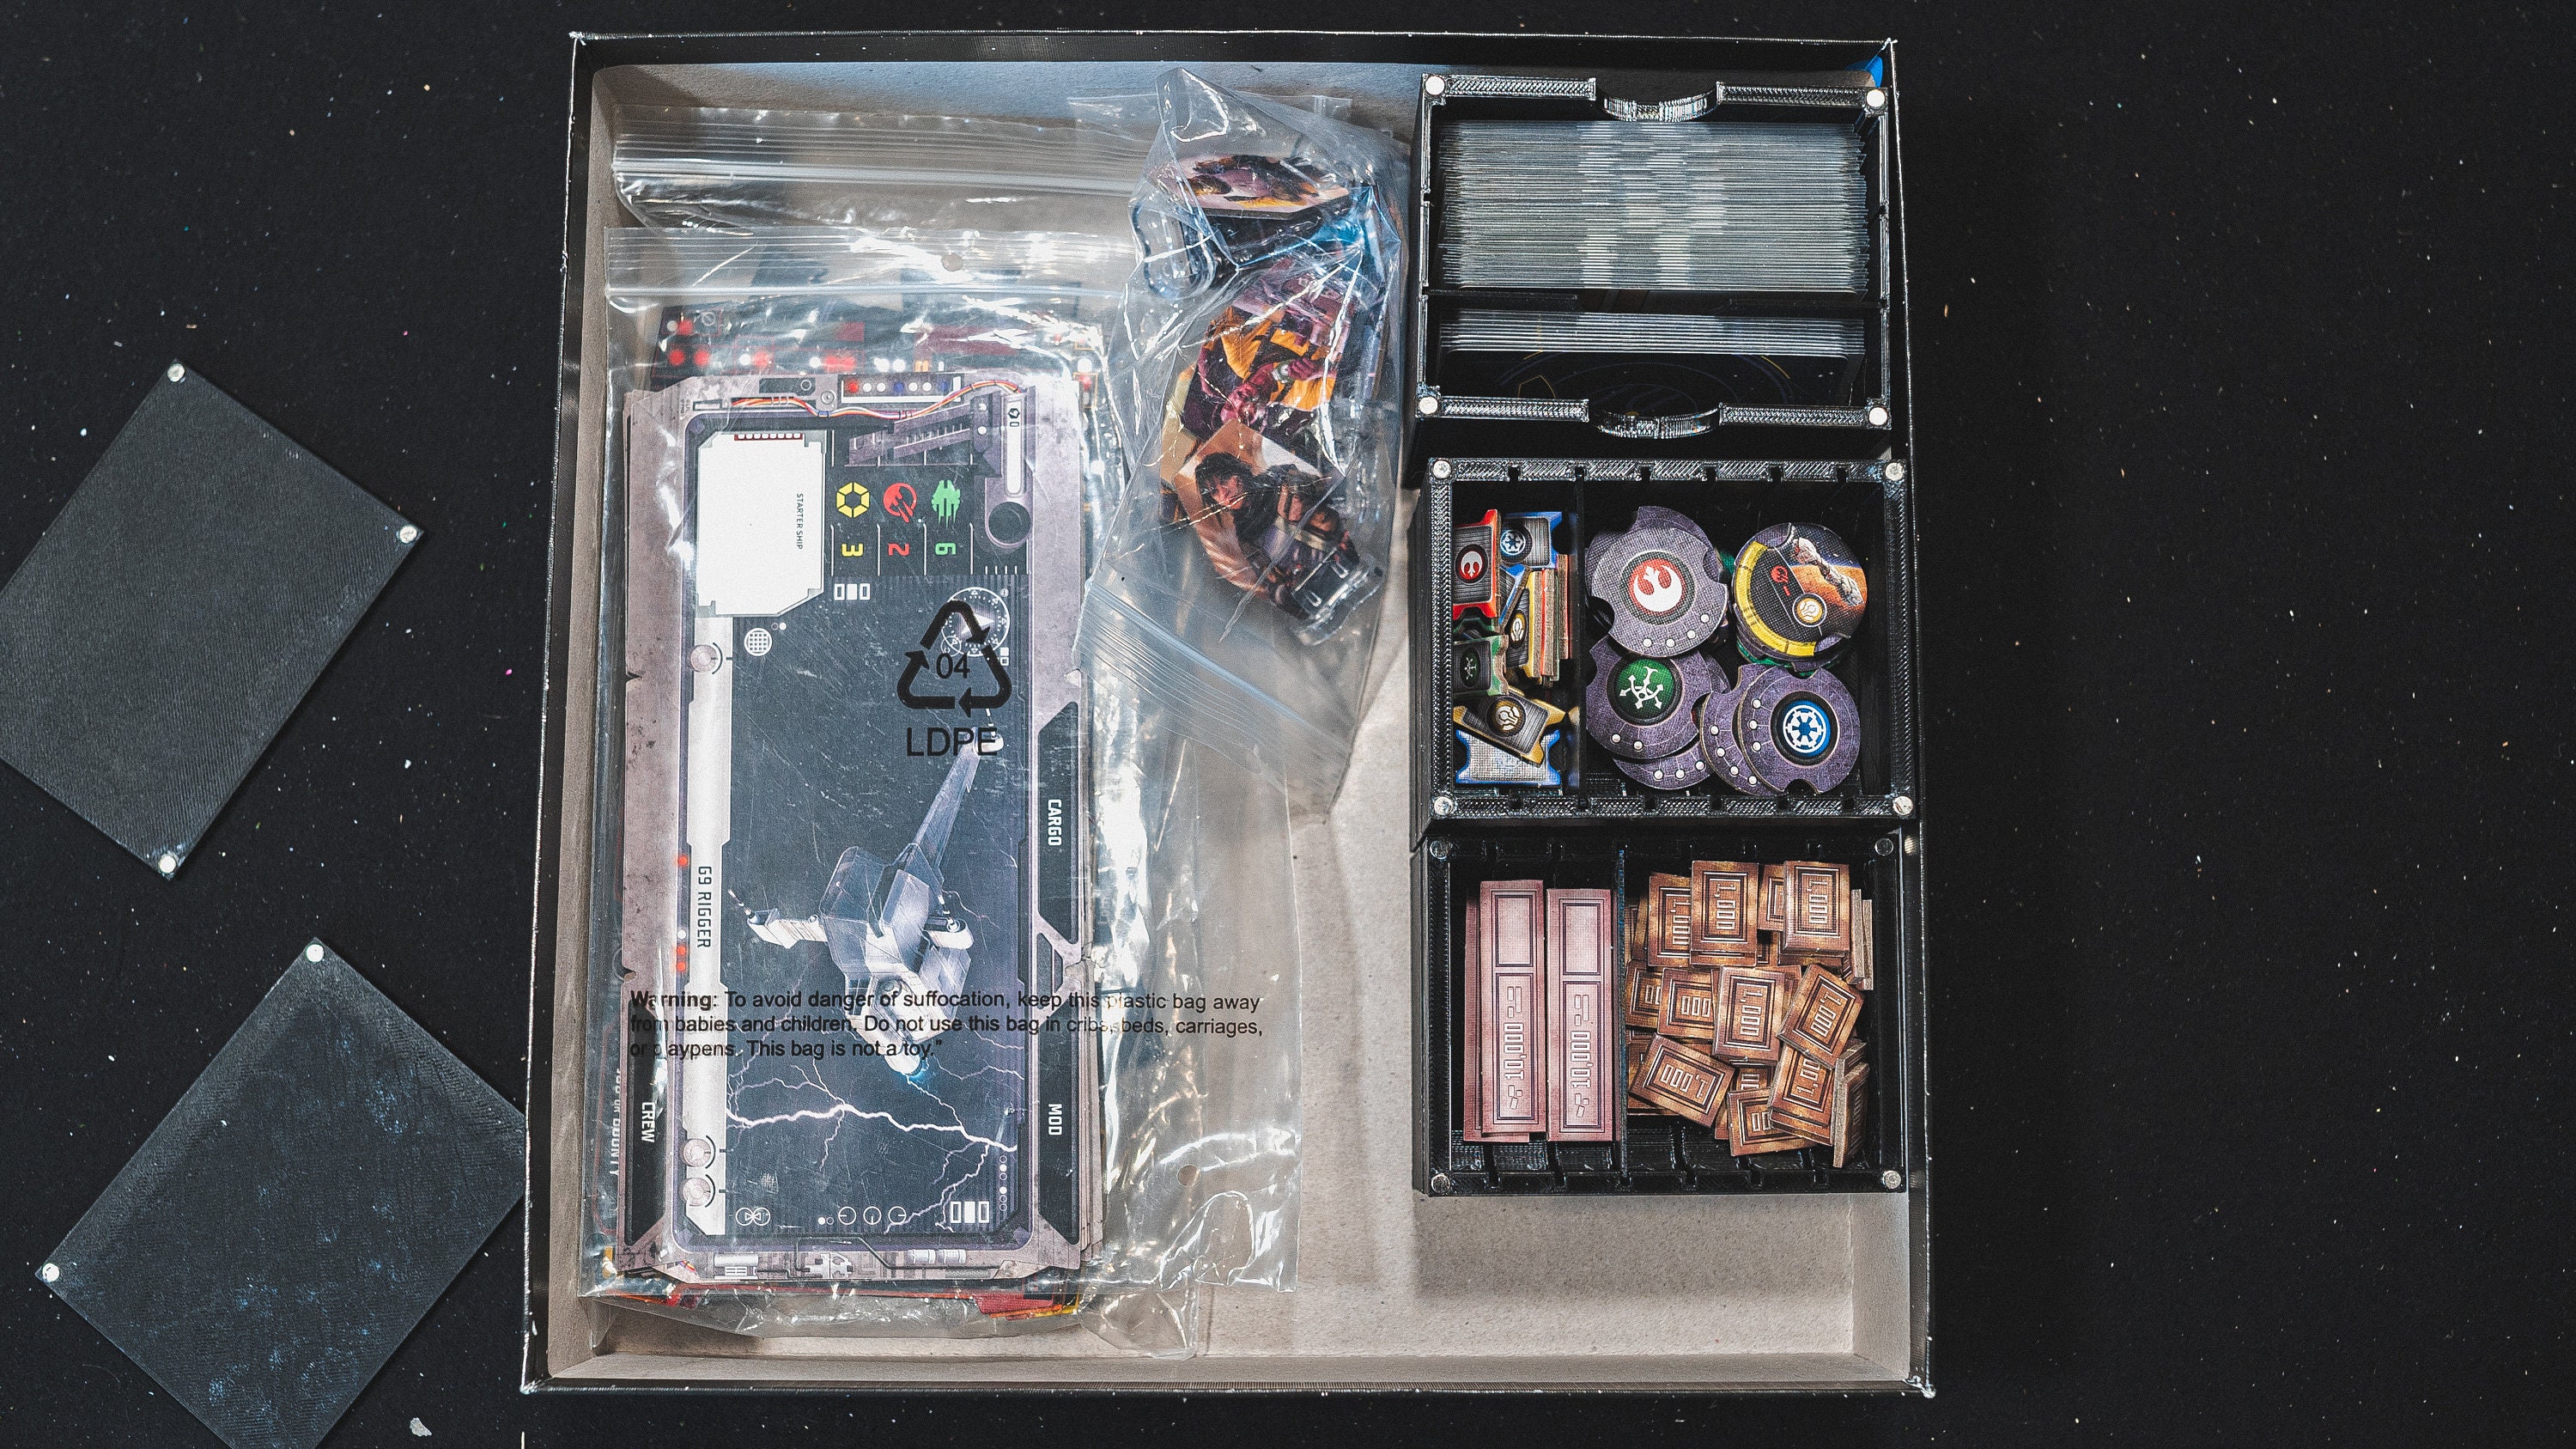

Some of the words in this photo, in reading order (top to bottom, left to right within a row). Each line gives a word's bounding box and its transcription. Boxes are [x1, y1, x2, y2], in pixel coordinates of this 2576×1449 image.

[841, 543, 864, 557] 3
[888, 543, 910, 557] 2
[935, 542, 957, 556] 6
[936, 653, 970, 679] 04
[906, 727, 998, 757] LDPE
[1048, 799, 1062, 846] CARGO
[698, 866, 713, 885] G9
[1714, 883, 1736, 930] 1,000
[1806, 878, 1828, 924] 1,000
[697, 892, 712, 948] RIGGER
[630, 989, 717, 1011] Warning:
[724, 991, 746, 1008] To
[752, 990, 802, 1008] avoid
[808, 990, 873, 1011] danger
[879, 990, 899, 1008] of
[903, 990, 1011, 1008] suffocation,
[1018, 991, 1062, 1011] keep
[1069, 991, 1100, 1008] this
[1107, 992, 1166, 1009] plastic
[1173, 993, 1206, 1013] bag
[1212, 995, 1261, 1014] away
[1740, 989, 1763, 1037] 1,000
[1810, 991, 1842, 1038] 1,000
[675, 1015, 735, 1032] babies
[741, 1016, 775, 1032] and
[781, 1016, 857, 1032] children.
[864, 1016, 890, 1032] Do
[896, 1017, 924, 1032] not
[930, 1019, 963, 1032] use
[969, 1016, 999, 1032] this
[1005, 1016, 1039, 1035] bag
[1046, 1016, 1061, 1032] in
[1066, 1016, 1114, 1035] cribs,
[1121, 1017, 1169, 1036] beds,
[1176, 1018, 1263, 1038] carriages,
[629, 1043, 648, 1056] or
[653, 1043, 737, 1061] paypens.
[746, 1039, 786, 1056] This
[791, 1040, 824, 1060] bag
[830, 1040, 846, 1056] is
[852, 1042, 880, 1056] not
[886, 1043, 897, 1056] a
[903, 1039, 943, 1060] toy."
[1504, 1022, 1527, 1081] 10,000
[1571, 1030, 1594, 1088] 10,000
[1660, 1063, 1709, 1099] 1,000
[1795, 1058, 1820, 1097] 1,00
[641, 1101, 656, 1143] CREW
[1048, 1103, 1063, 1135] MOD
